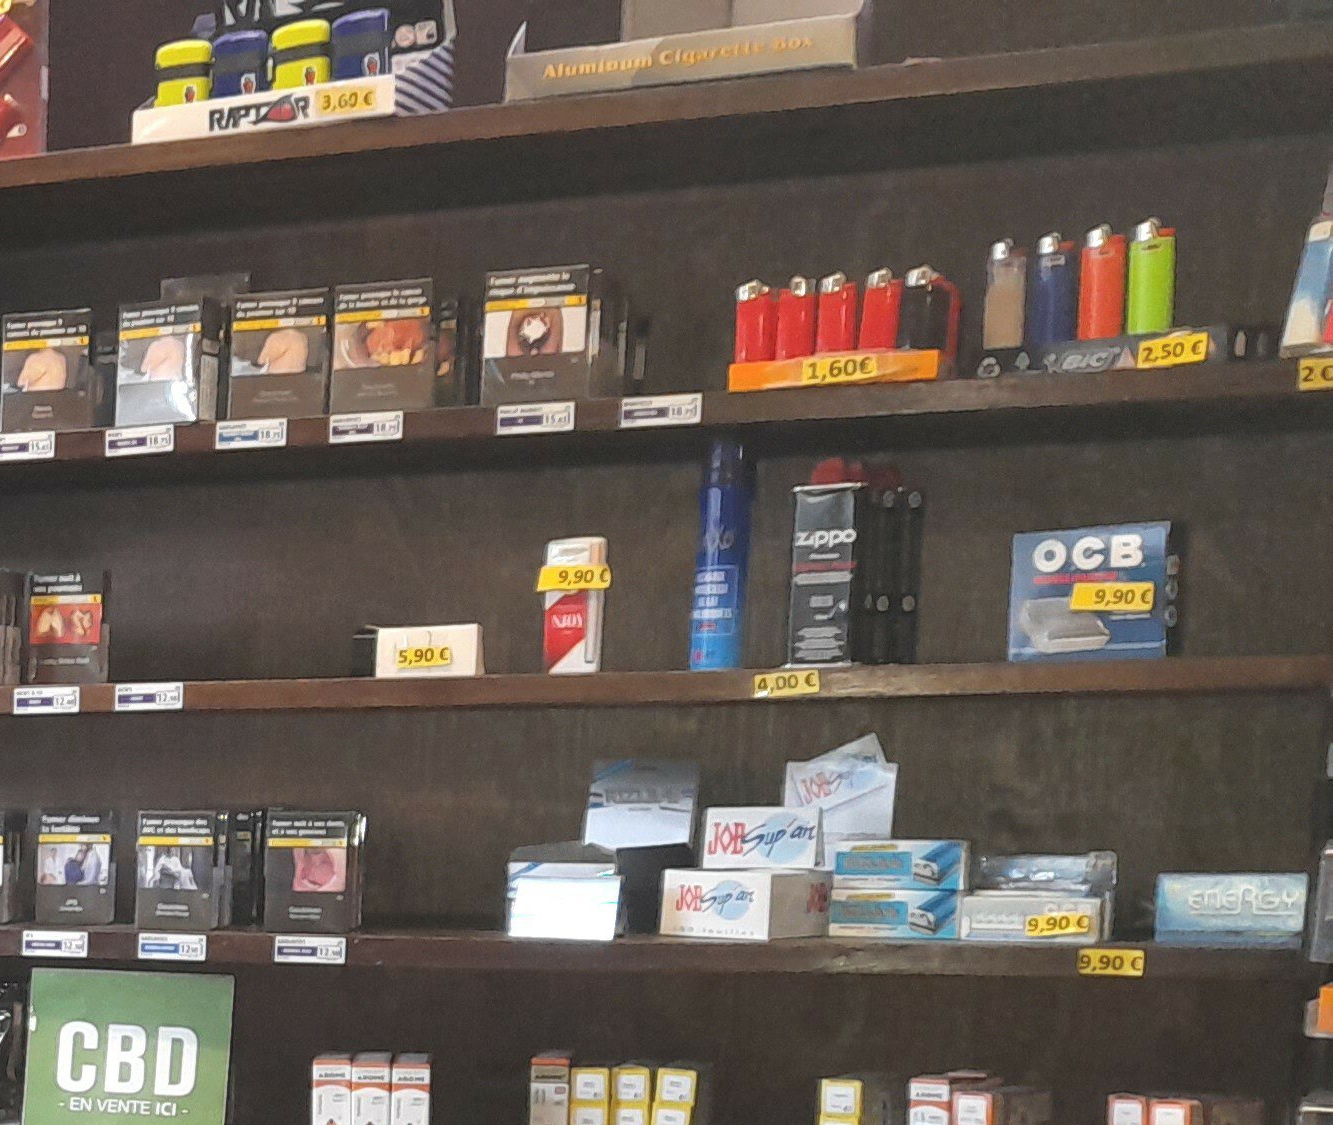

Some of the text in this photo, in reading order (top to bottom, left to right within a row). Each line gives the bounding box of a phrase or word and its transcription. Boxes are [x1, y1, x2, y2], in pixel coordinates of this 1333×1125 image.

[1142, 339, 1204, 363] 2,50 €
[807, 357, 873, 383] 1,60€
[1033, 534, 1144, 573] OCB
[558, 568, 609, 587] 9,90 €
[1094, 588, 1151, 607] 9,90 €
[398, 647, 449, 666] 5,90 €
[805, 672, 817, 688] €
[707, 821, 746, 855] JOB
[676, 884, 703, 912] JOB
[1027, 915, 1089, 935] 9,90 €
[1079, 954, 1143, 973] 9,90 €
[56, 1020, 196, 1098] CBD
[70, 1098, 178, 1117] EN VENTE ICI
